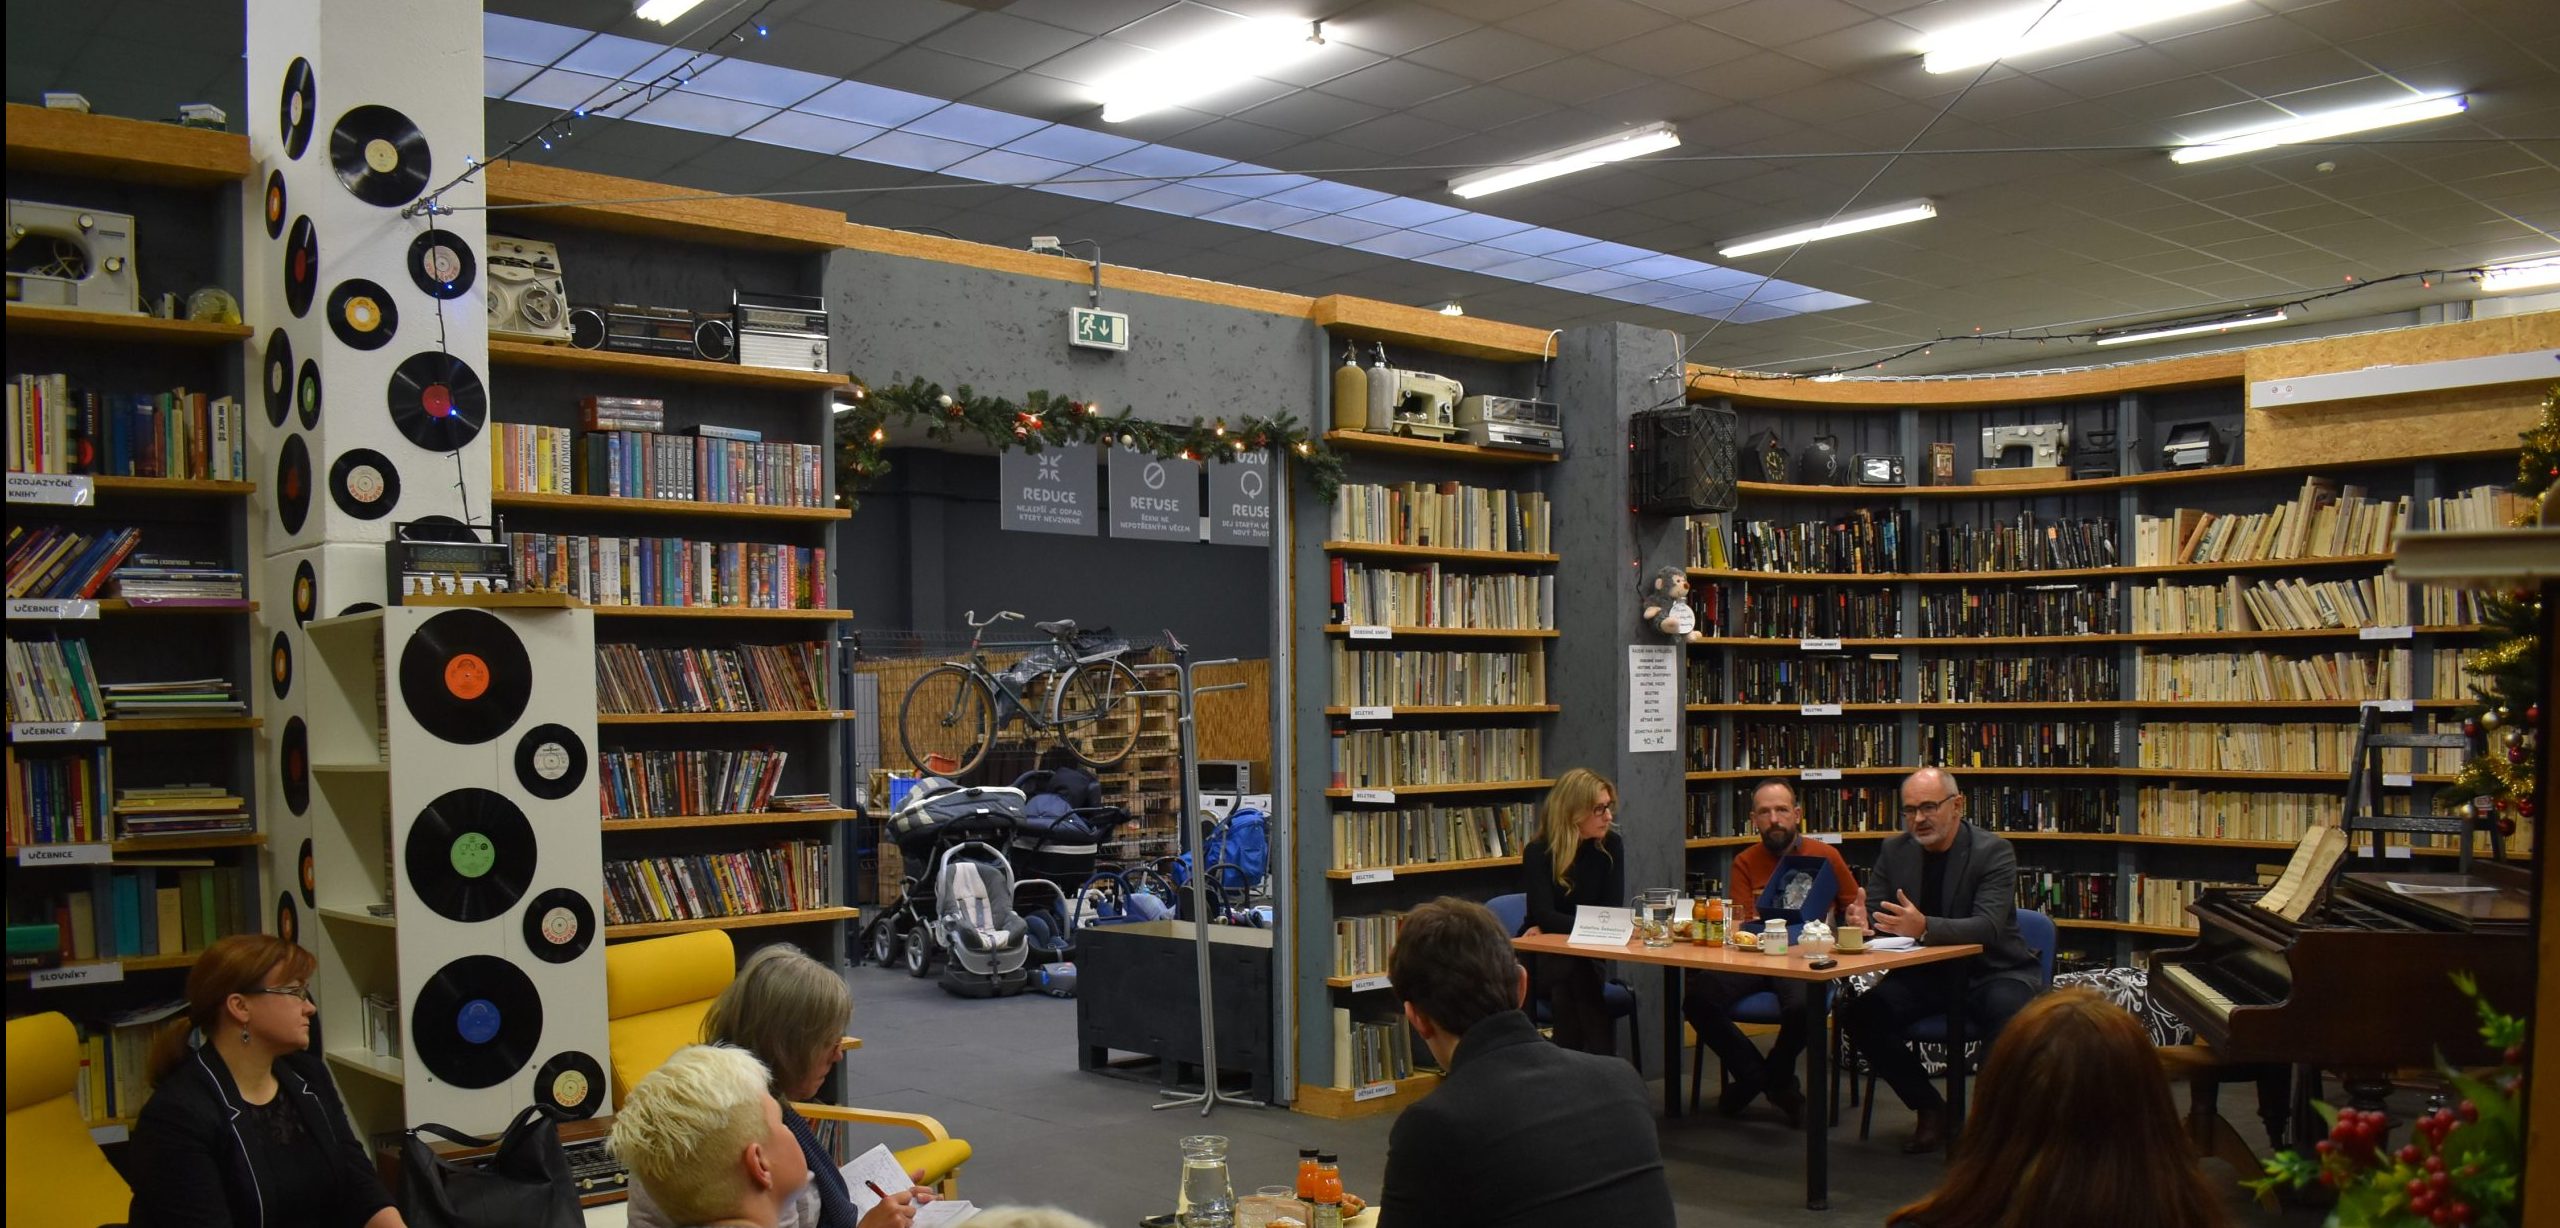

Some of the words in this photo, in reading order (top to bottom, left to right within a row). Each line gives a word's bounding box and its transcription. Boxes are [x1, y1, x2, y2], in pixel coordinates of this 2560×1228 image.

[561, 432, 570, 474] OLOMOUC
[8, 478, 73, 487] CIZOJAZYČNÉ
[1023, 487, 1076, 504] REDUCE
[1130, 496, 1179, 512] REFUSE
[1232, 504, 1269, 518] REUSE
[14, 604, 59, 613] UČEBNICE
[21, 727, 67, 735] UČEBNICE
[28, 851, 73, 860] UČEBNICE
[40, 970, 87, 981] SLOVNÍKY
